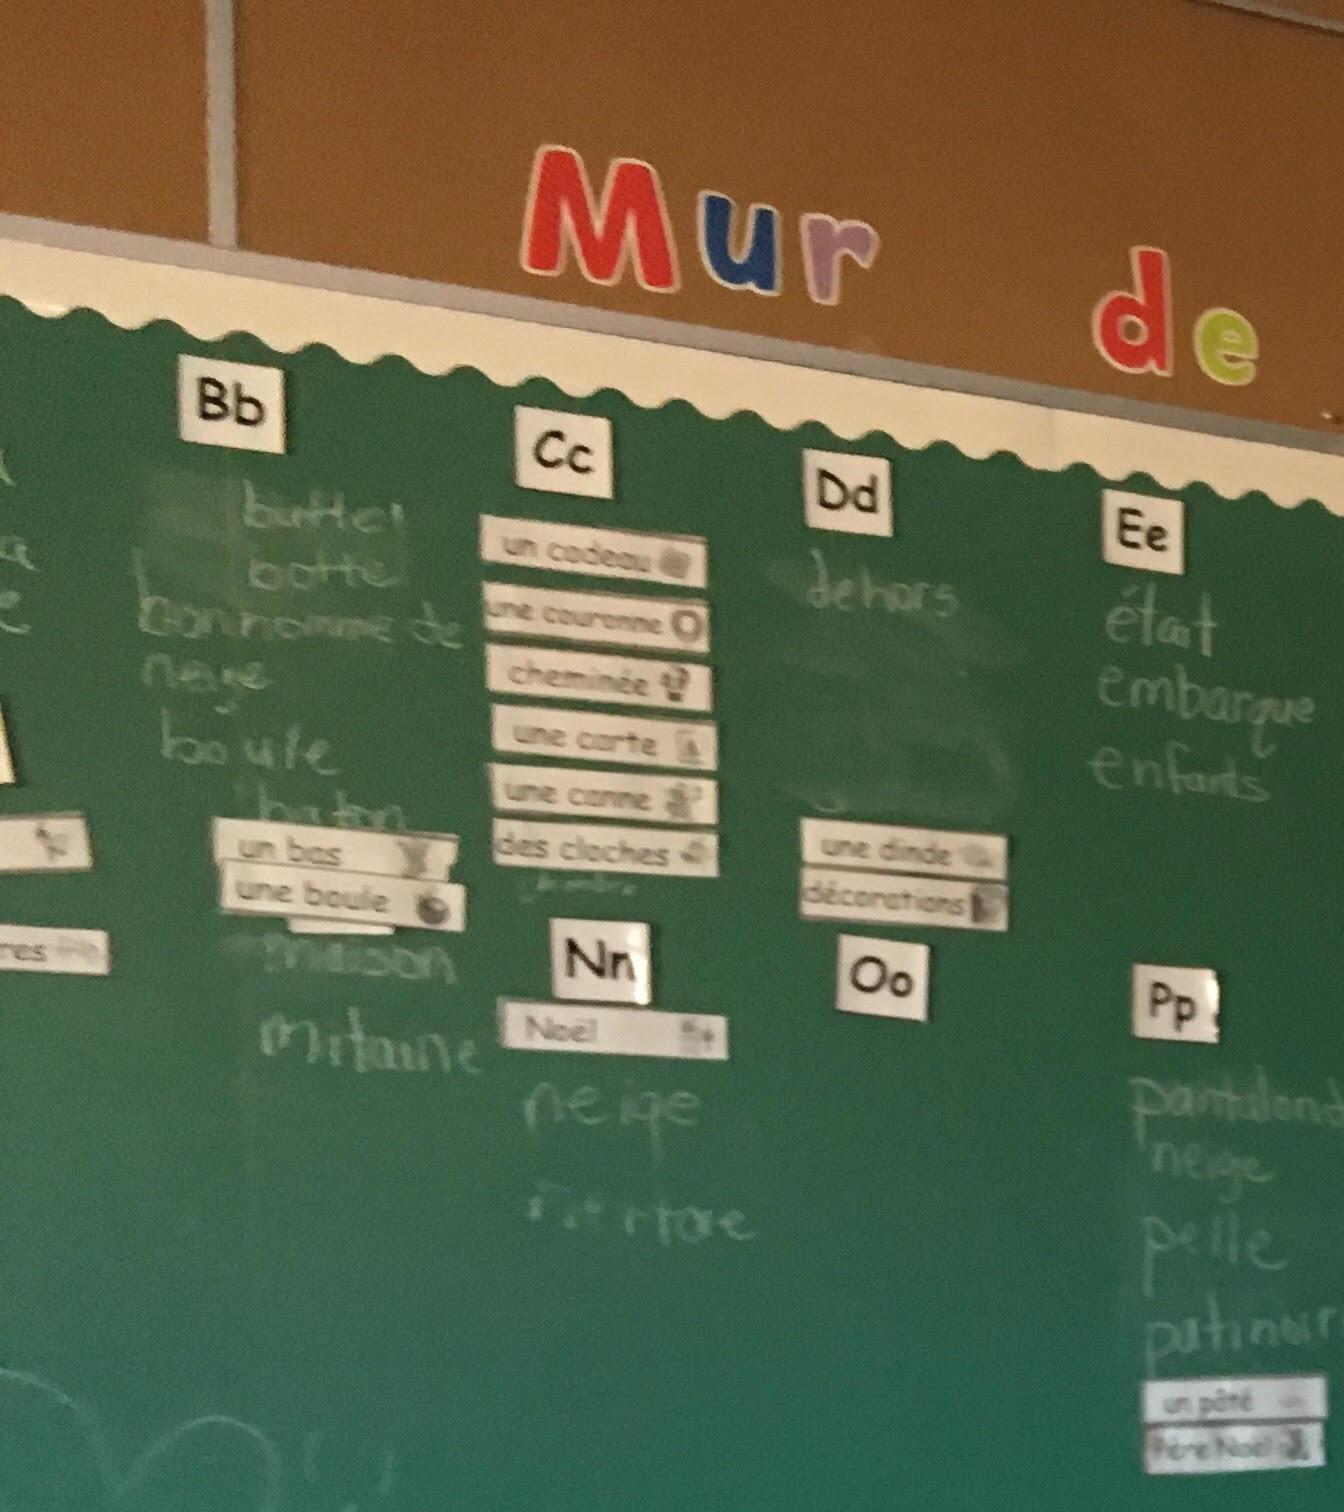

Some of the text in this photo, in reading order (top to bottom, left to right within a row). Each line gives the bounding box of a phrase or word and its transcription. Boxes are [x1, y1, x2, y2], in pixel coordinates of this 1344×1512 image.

[520, 144, 879, 305] Mur
[1093, 246, 1259, 386] de
[200, 377, 266, 427] Bb
[533, 430, 595, 475] Cc
[817, 468, 879, 515] Dd
[1117, 508, 1170, 553] Ee
[549, 539, 651, 573] cadeau
[542, 604, 664, 635] couronne
[512, 724, 659, 757] une carte
[504, 783, 557, 804] une
[498, 830, 549, 859] des
[236, 878, 391, 914] une boule
[564, 938, 637, 981] Nn
[850, 955, 914, 998] Oo
[1150, 982, 1197, 1032] Pp
